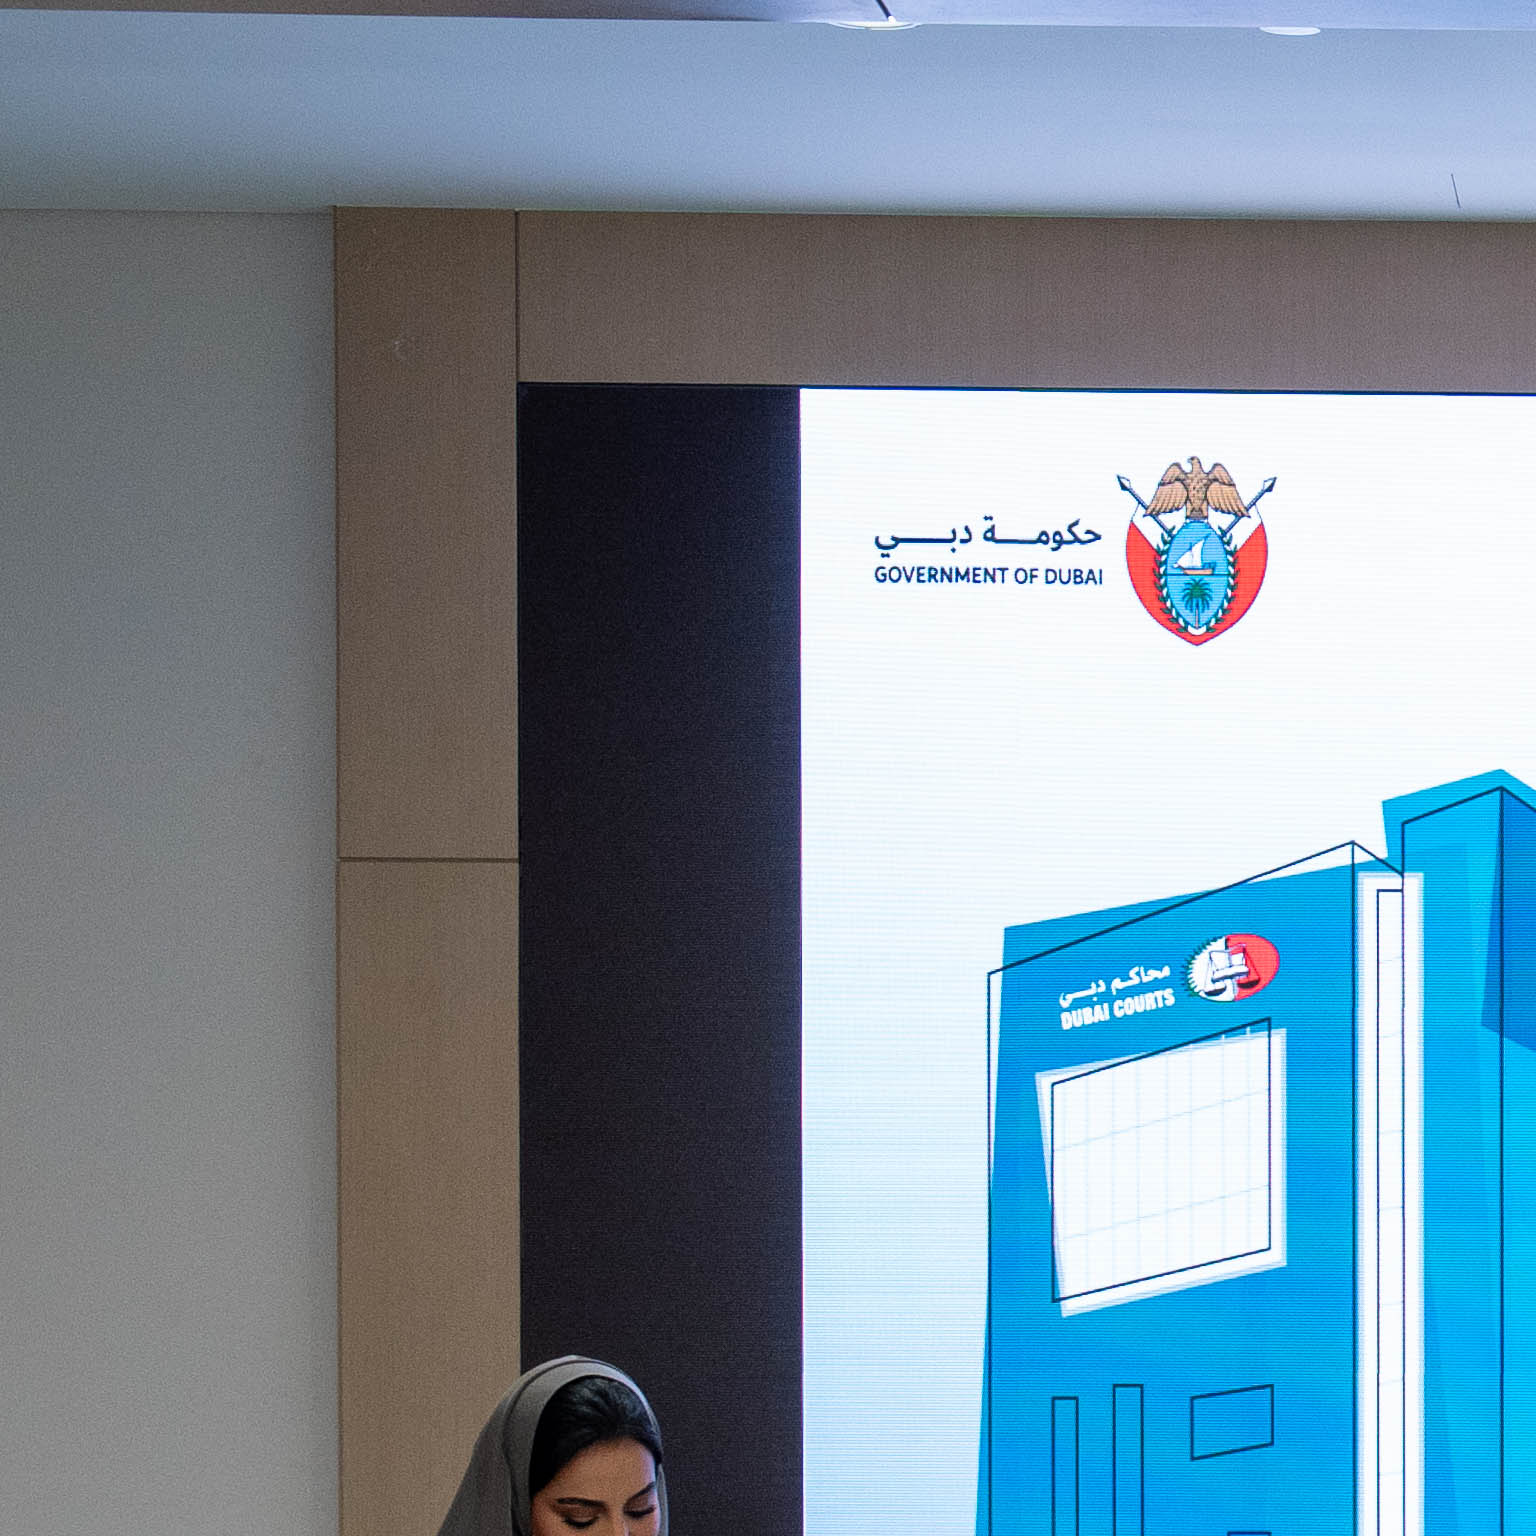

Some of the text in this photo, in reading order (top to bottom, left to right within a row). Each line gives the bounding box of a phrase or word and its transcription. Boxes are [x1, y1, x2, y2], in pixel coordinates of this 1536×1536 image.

[874, 515, 1102, 559] حكومة دبي
[874, 565, 1103, 586] GOVERNMENT OF DUBAI
[1110, 965, 1171, 995] محاكم
[1060, 988, 1176, 1031] DUBAI COURTS
